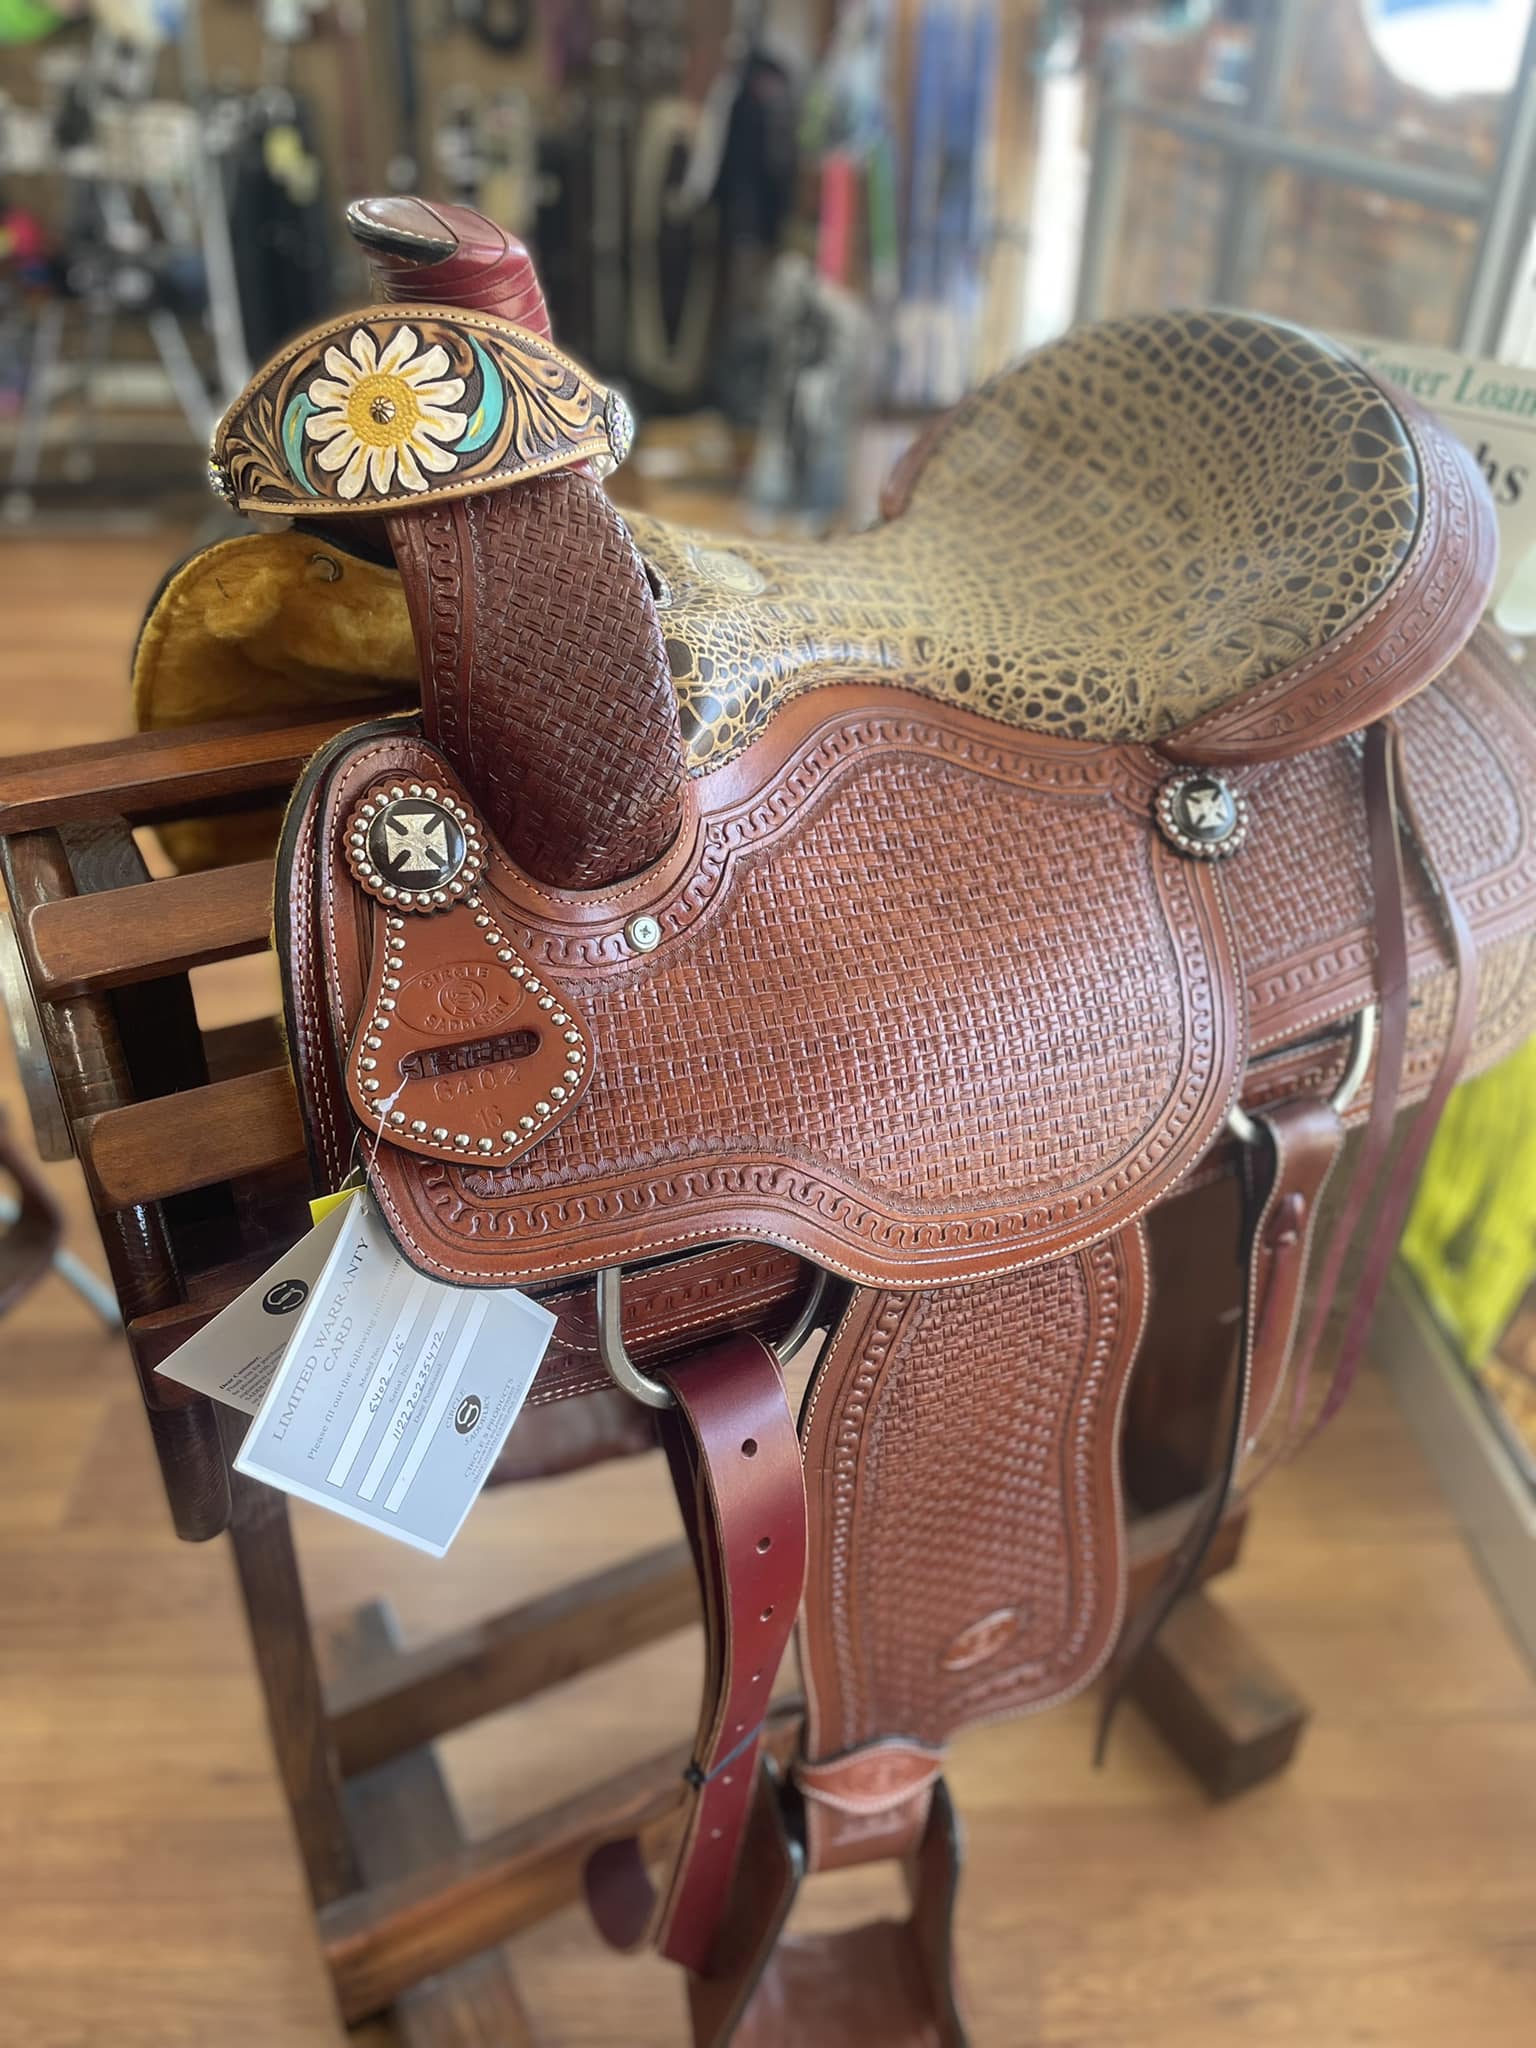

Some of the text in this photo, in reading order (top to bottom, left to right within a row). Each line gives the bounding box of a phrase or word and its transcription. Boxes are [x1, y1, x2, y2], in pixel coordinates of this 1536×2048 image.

[418, 966, 490, 989] CIRCLE
[423, 994, 510, 1034] SADDLERY
[272, 1354, 317, 1441] LIMITED
[314, 1236, 369, 1349] WARRANTY
[323, 1316, 353, 1372] CARD
[307, 1423, 328, 1460] Please
[332, 1389, 345, 1409] out
[342, 1369, 353, 1390] the
[349, 1318, 377, 1370] following
[446, 1390, 466, 1429] CIRCLE
